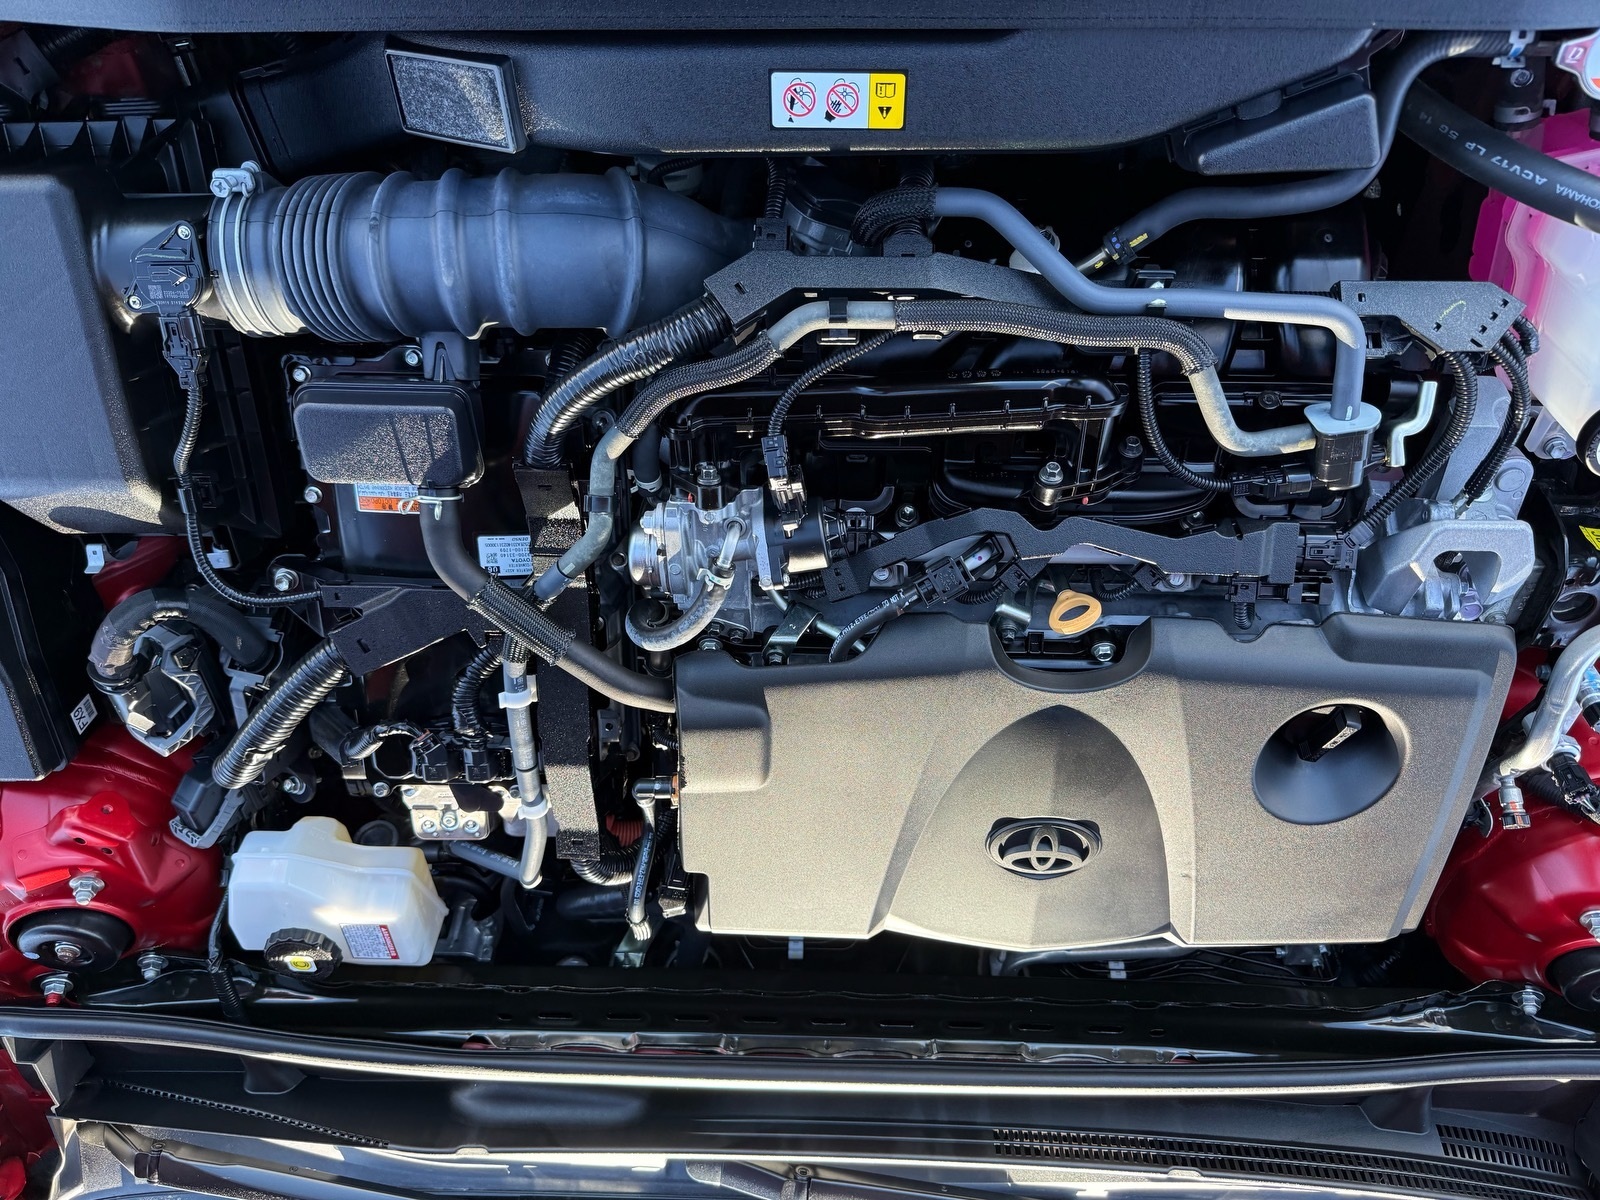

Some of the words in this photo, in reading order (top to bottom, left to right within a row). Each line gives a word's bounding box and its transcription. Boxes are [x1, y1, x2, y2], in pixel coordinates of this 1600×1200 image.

[1464, 141, 1486, 156] LP
[1490, 156, 1548, 186] ACV17
[73, 706, 89, 731] FX9
